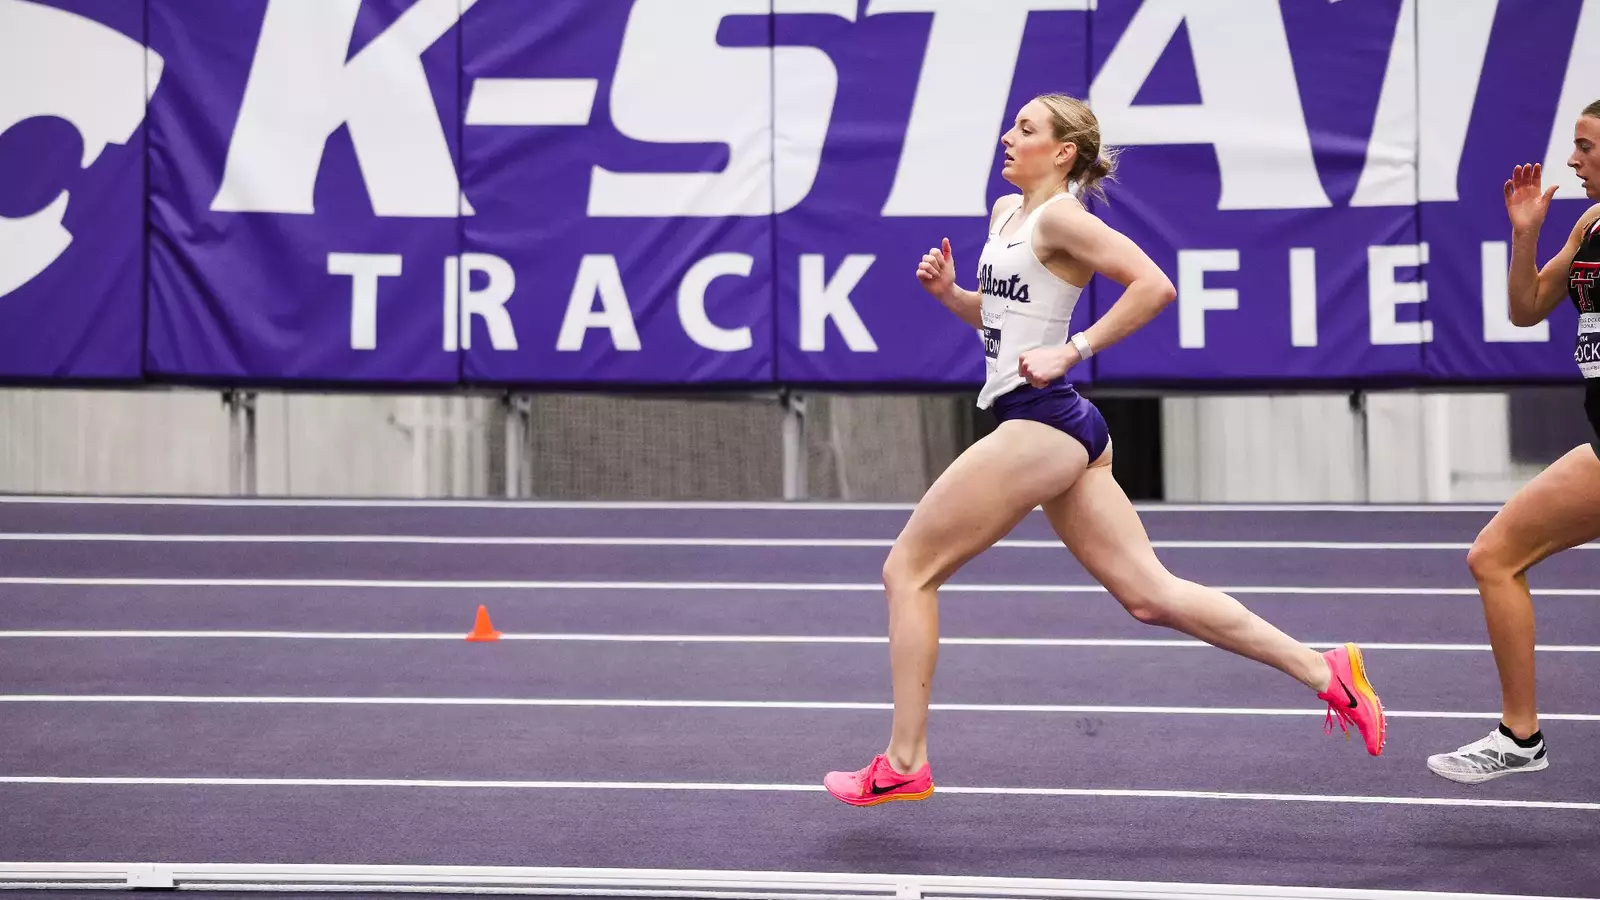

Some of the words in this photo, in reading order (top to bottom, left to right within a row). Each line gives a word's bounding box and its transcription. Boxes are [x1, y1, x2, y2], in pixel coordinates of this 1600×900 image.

[210, 0, 1600, 217] K-STAT
[327, 252, 878, 352] TRACK
[979, 263, 1031, 303] ldcats
